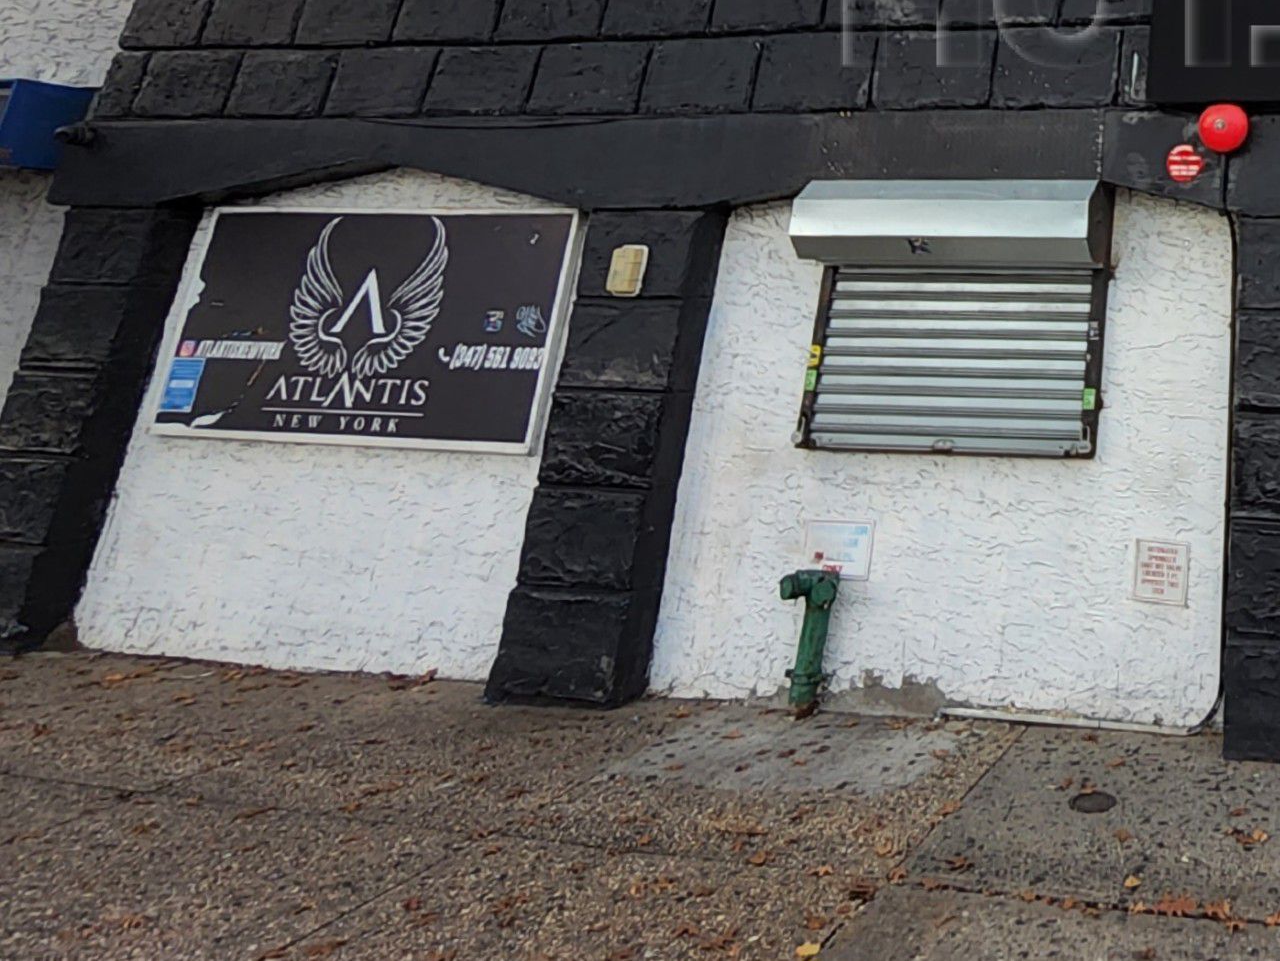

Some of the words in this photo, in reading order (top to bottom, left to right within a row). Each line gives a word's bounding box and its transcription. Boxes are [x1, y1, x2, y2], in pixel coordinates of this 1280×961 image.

[265, 371, 430, 408] ATLANTIS
[272, 414, 323, 428] NEW
[338, 416, 400, 433] YORK
